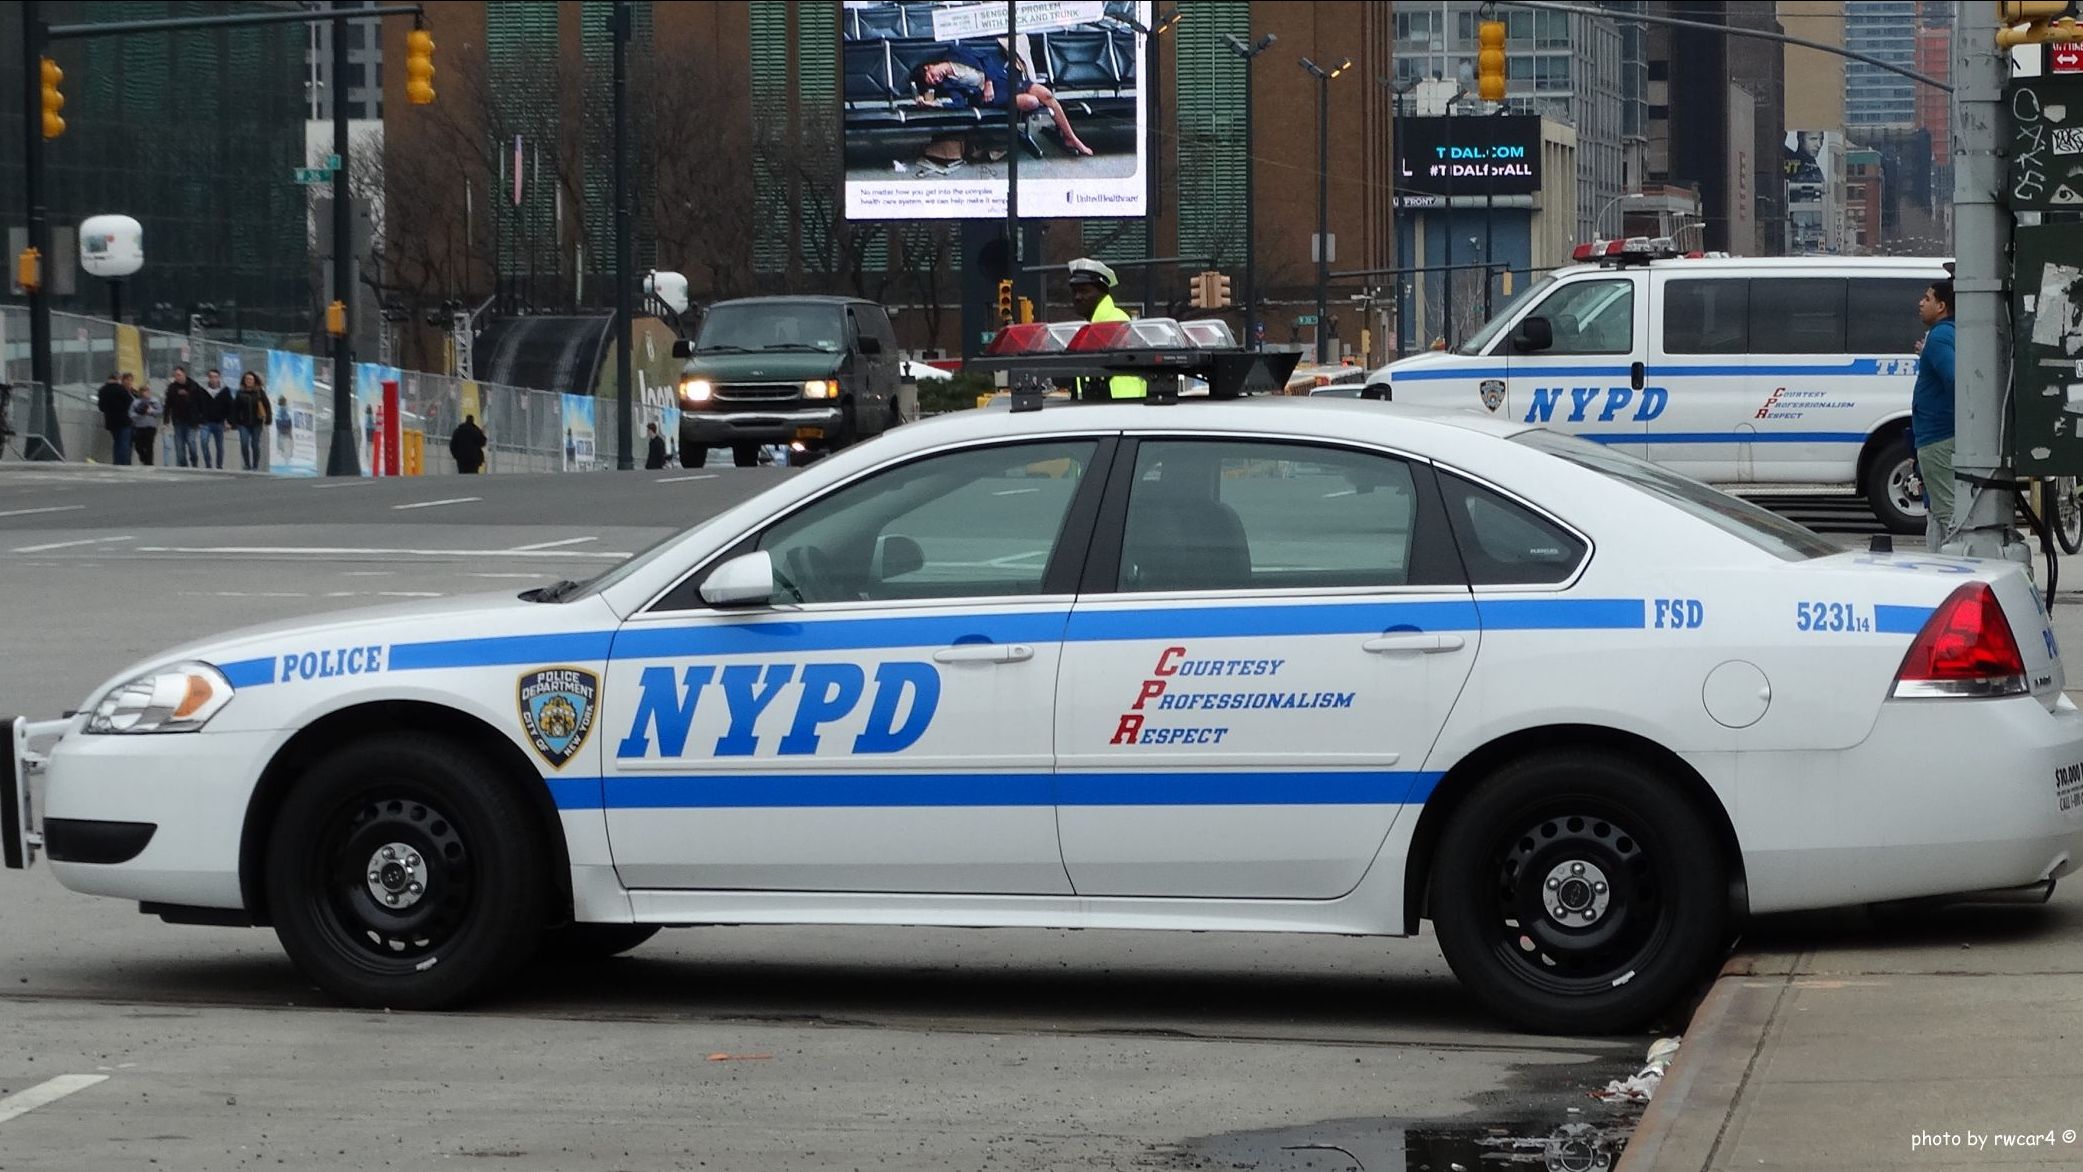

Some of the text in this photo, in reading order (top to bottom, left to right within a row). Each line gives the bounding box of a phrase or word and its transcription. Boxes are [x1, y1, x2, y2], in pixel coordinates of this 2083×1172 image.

[980, 2, 1061, 19] SENSO PROBLEM
[982, 17, 1004, 29] WITH
[1003, 15, 1028, 26] NCK
[1029, 13, 1048, 23] AND
[1050, 11, 1079, 20] TRUNK
[1435, 146, 1524, 159] TDAL.COM
[1876, 359, 1921, 375] TR
[1524, 387, 1669, 422] NYPD
[1655, 599, 1704, 629] FSD
[1797, 602, 1855, 632] 5231
[280, 645, 383, 683] POLICE
[1154, 647, 1285, 676] COURTESY
[522, 681, 594, 700] DEPARTMENT
[537, 671, 581, 684] POLICE
[1132, 680, 1356, 710] PROFESSIONALISM
[616, 662, 941, 758] NYPD
[523, 705, 594, 757] CITY OF NEW YORK
[1109, 714, 1229, 745] RESPECT
